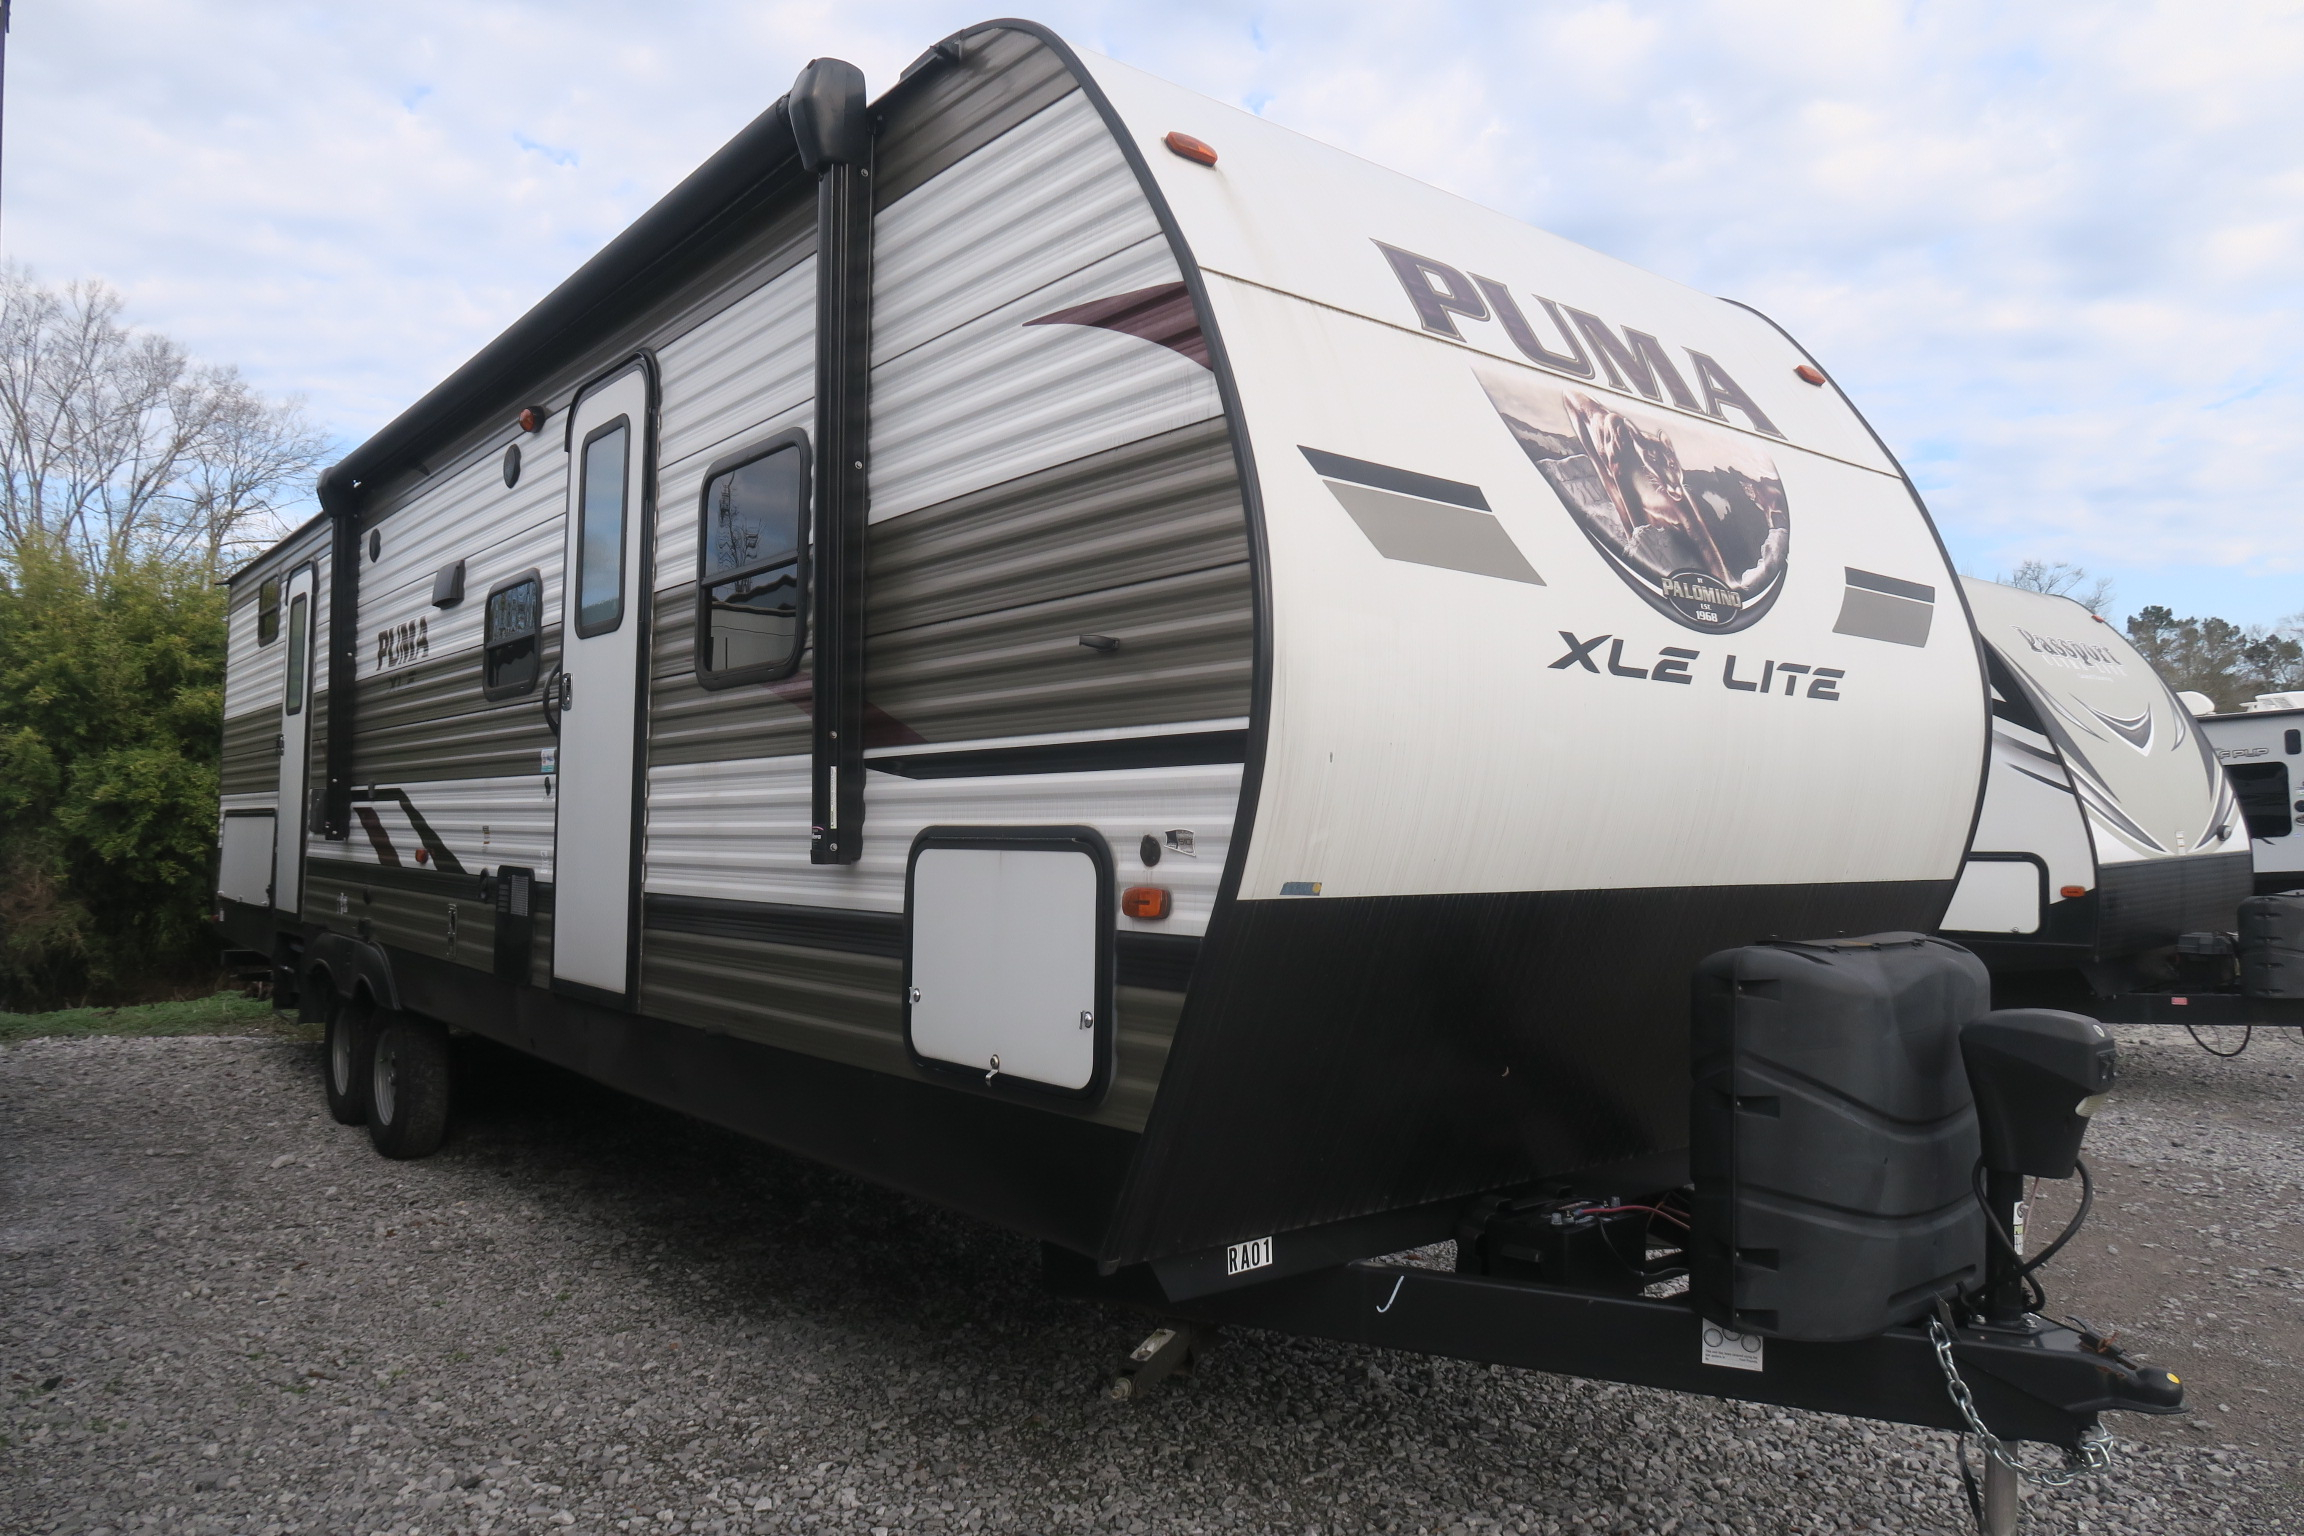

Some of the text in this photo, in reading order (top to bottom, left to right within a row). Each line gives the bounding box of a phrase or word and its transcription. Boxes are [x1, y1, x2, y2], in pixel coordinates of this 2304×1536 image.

[1368, 236, 1788, 442] PUMA
[1661, 577, 1741, 608] PALOMINO
[1695, 610, 1718, 623] 1968
[376, 615, 429, 672] PUMA
[1547, 630, 1846, 701] XLE LITE
[2008, 624, 2124, 667] Passport
